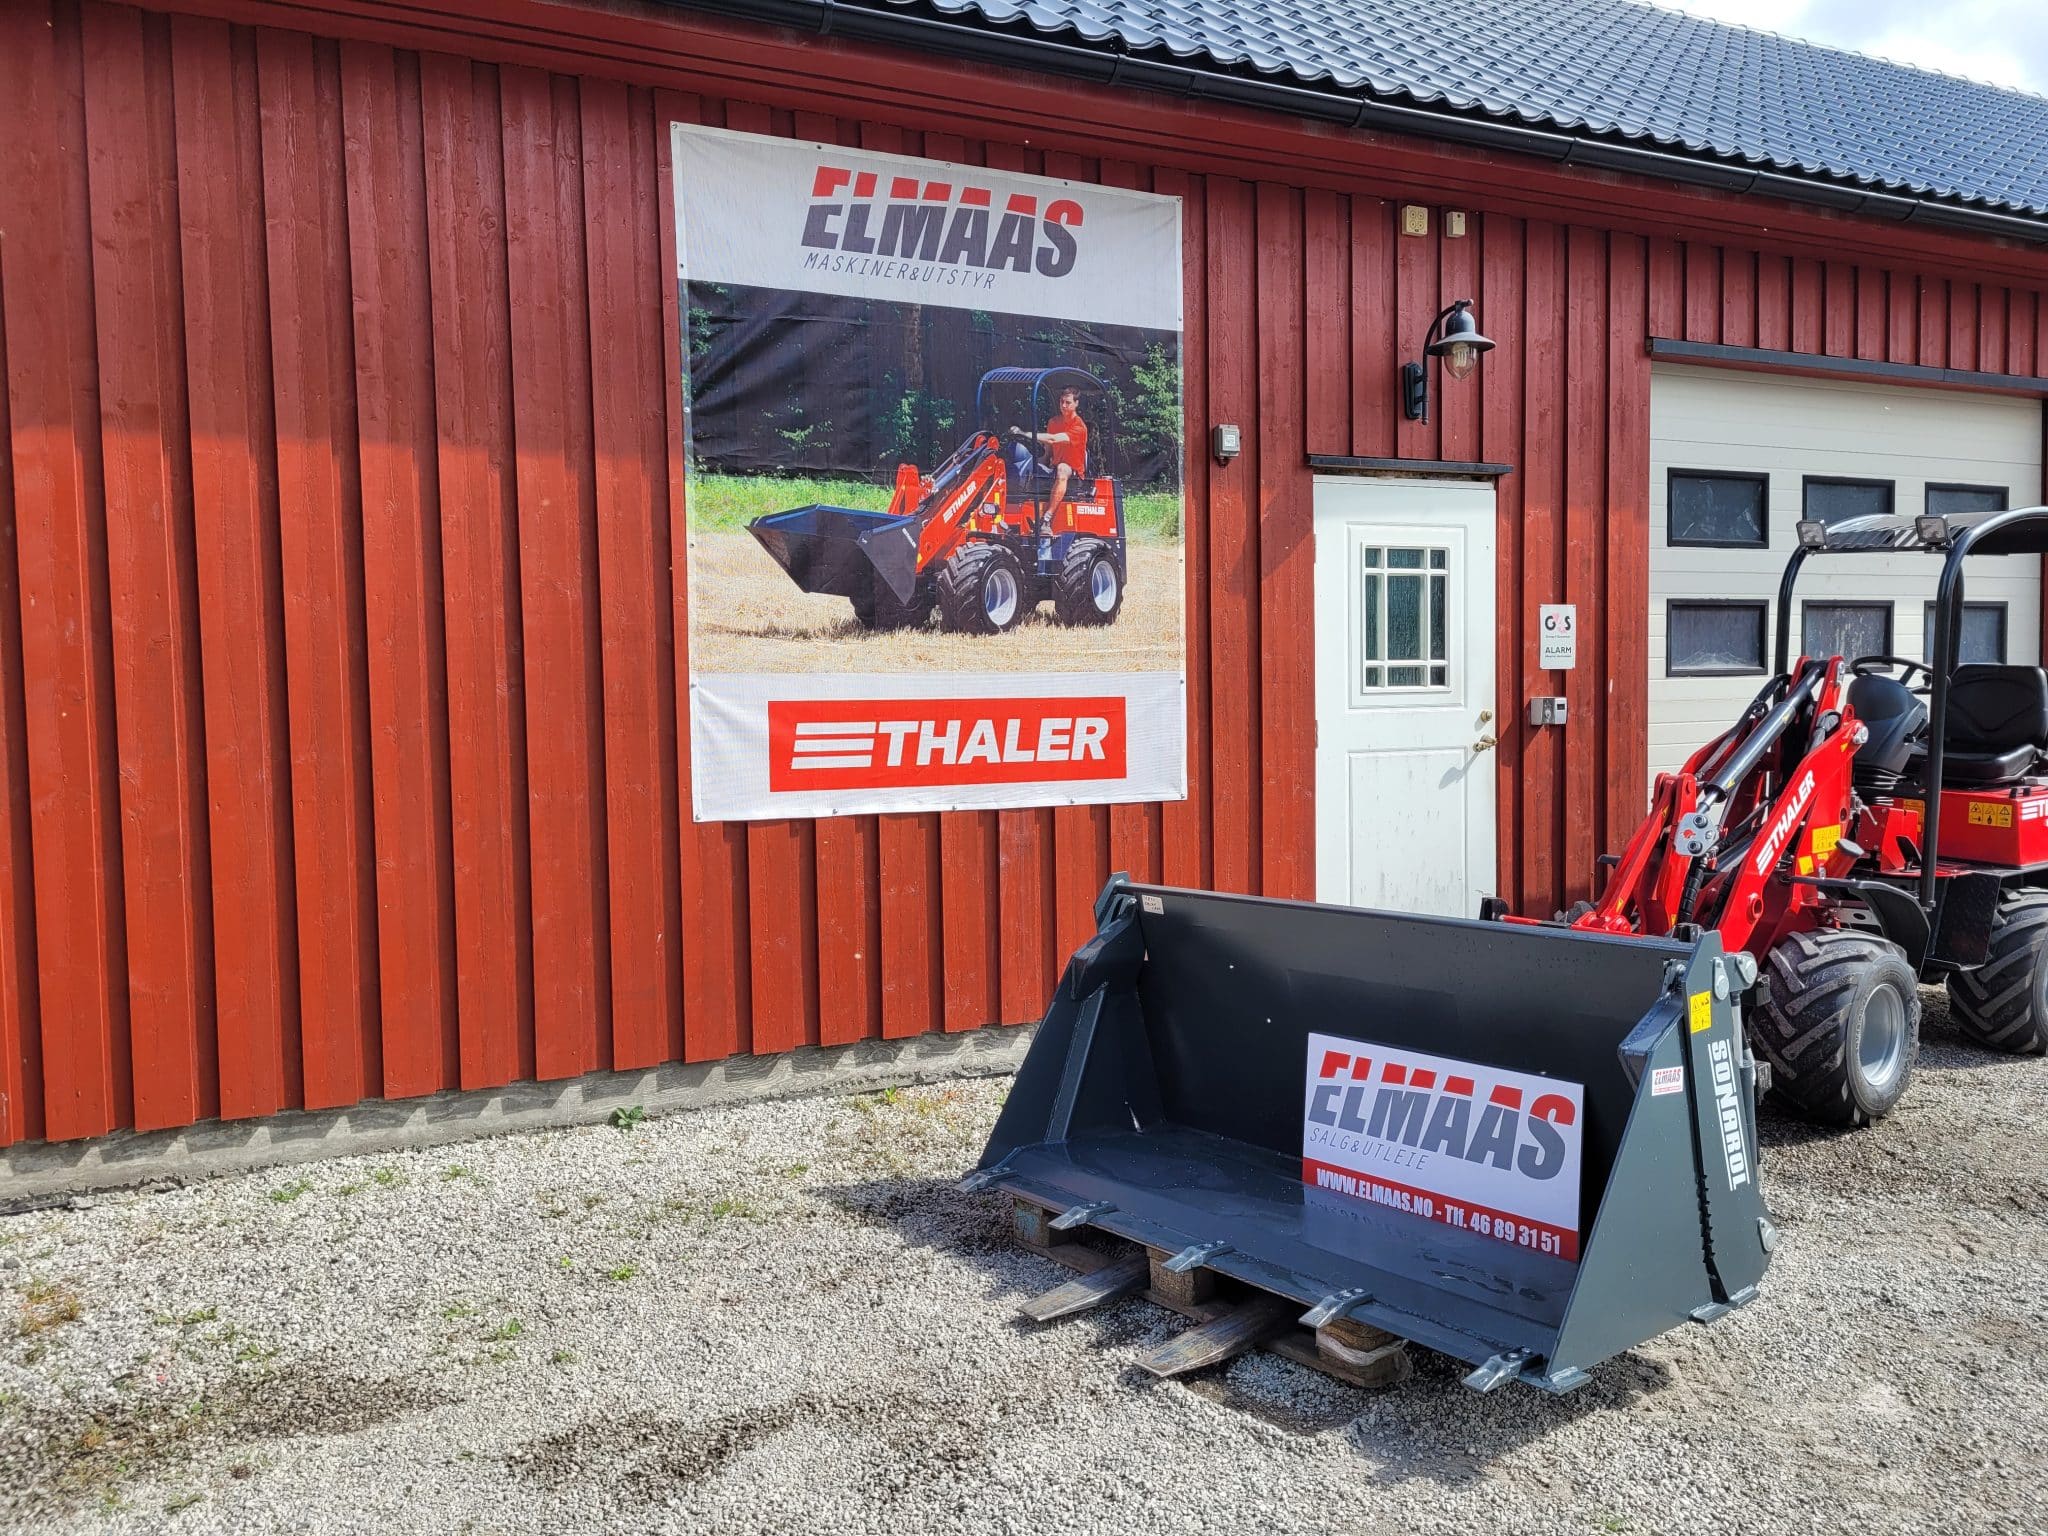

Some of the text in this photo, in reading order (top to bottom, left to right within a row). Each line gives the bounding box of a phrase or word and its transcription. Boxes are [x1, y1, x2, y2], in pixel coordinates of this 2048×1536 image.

[801, 165, 1084, 278] ELMAAS
[804, 252, 995, 289] MASKINER&UTSTYR
[1545, 646, 1572, 654] ALARM
[877, 717, 1110, 766] THALER
[1770, 770, 1815, 849] THALER
[1308, 1050, 1575, 1180] ELMAAS
[1309, 1127, 1429, 1170] SALG&UTLEIE
[1711, 1039, 1747, 1190] SONAROL
[1316, 1168, 1433, 1217] WWW.ELMAAS.NO
[1445, 1203, 1467, 1229] Tlf.
[1470, 1212, 1491, 1235] 46
[1494, 1218, 1515, 1242] 89
[1519, 1225, 1537, 1249] 31
[1541, 1231, 1560, 1255] 51
